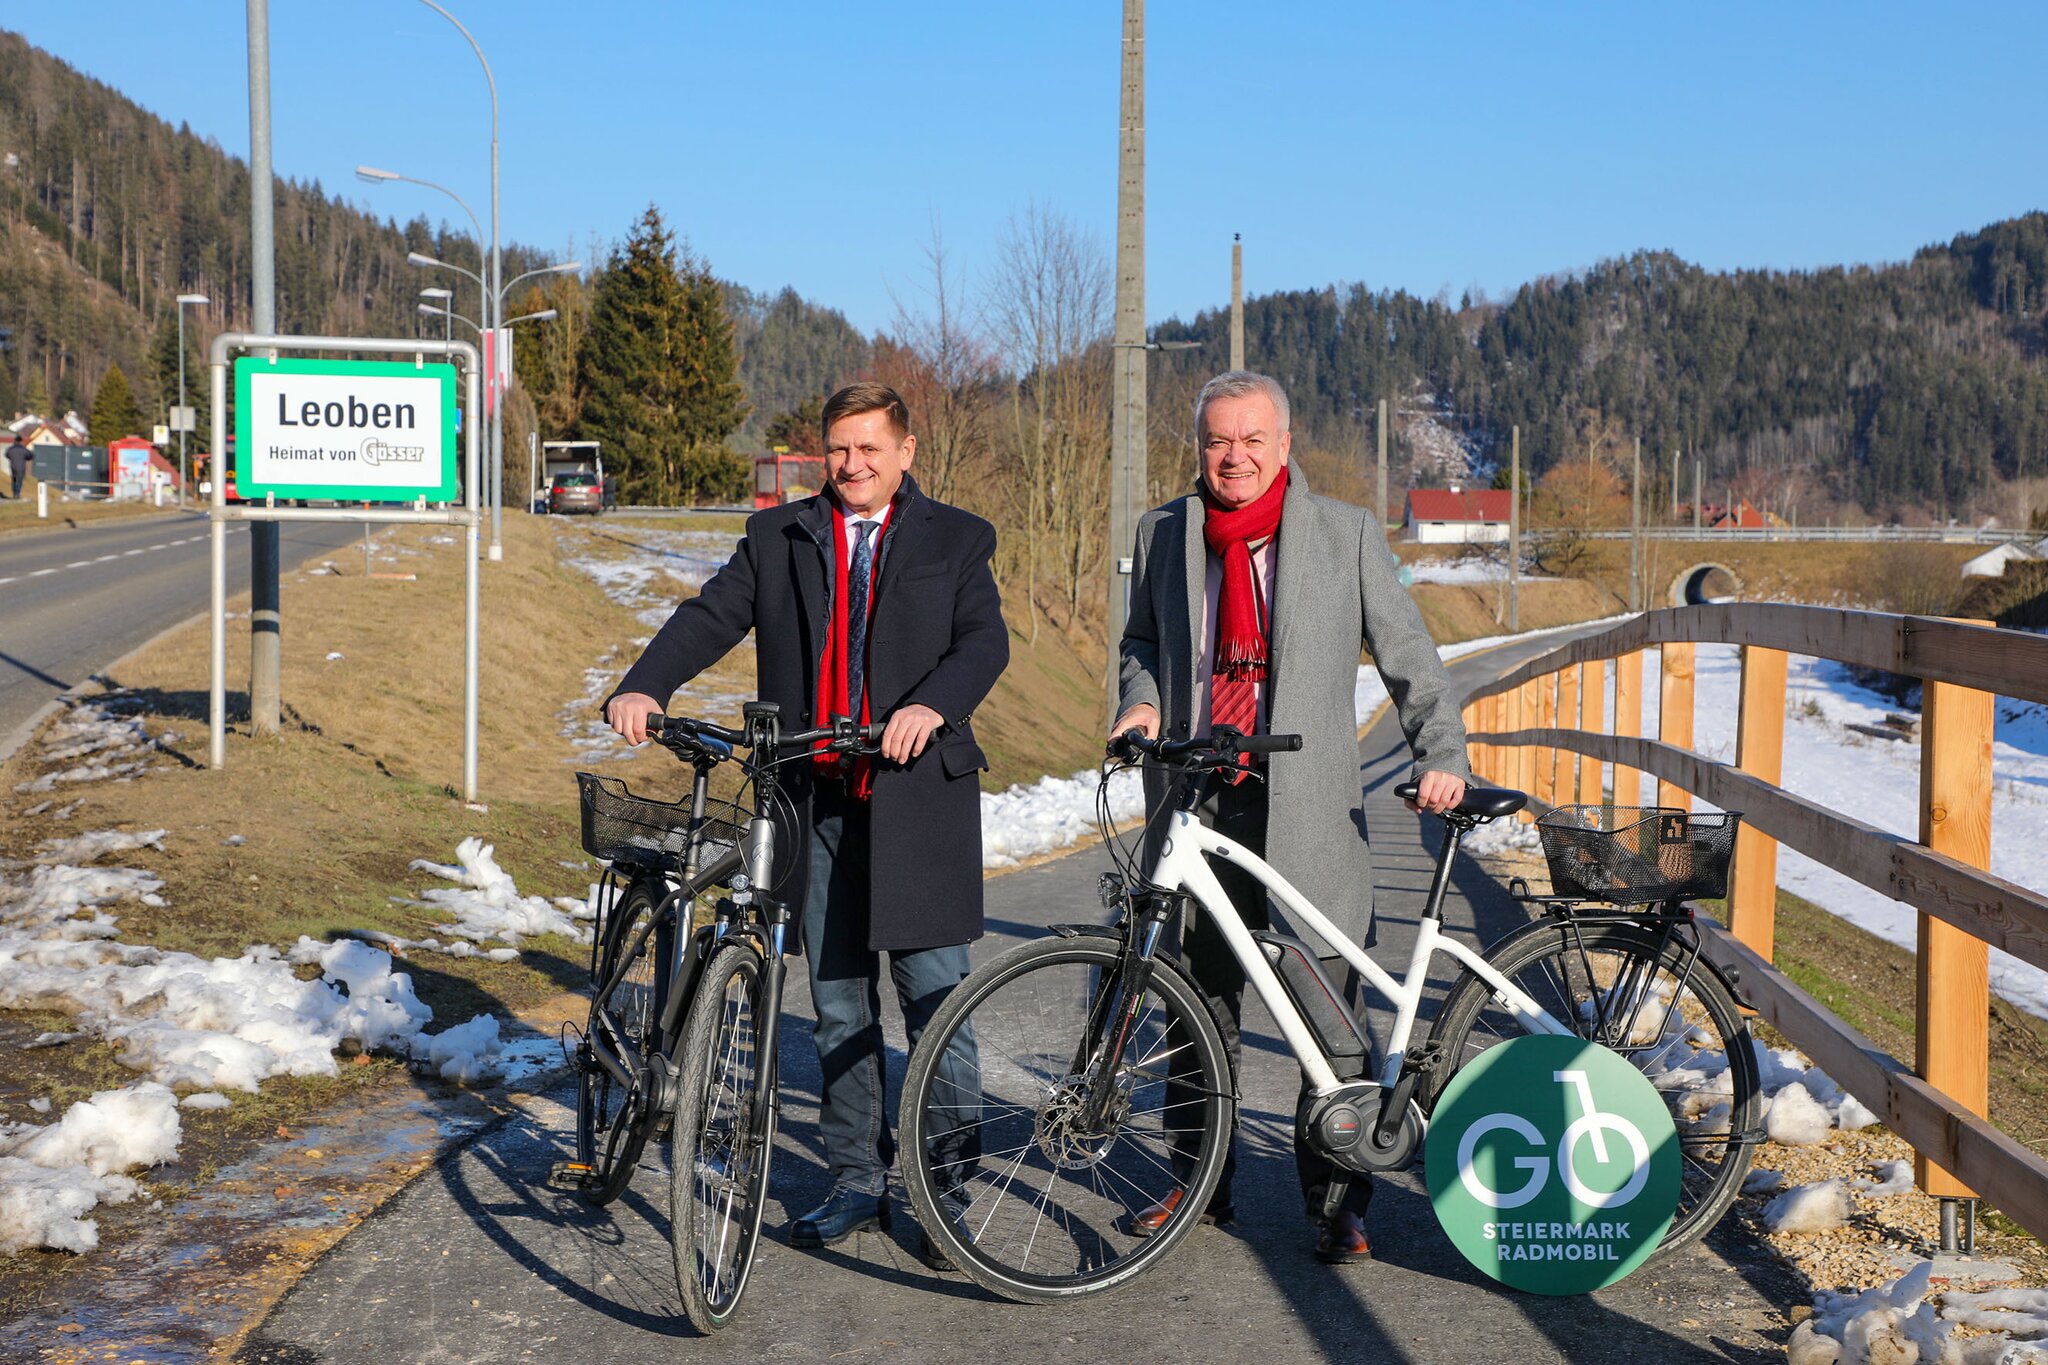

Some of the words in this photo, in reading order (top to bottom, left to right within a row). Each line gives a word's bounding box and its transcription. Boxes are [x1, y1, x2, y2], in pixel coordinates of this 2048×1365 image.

[279, 393, 415, 429] Leoben
[269, 446, 324, 461] Heimat
[329, 449, 356, 461] von
[360, 436, 424, 466] Gösser
[1457, 1112, 1650, 1209] GO
[1482, 1222, 1631, 1240] STEIERMARK
[1497, 1243, 1619, 1261] RADMOBIL
